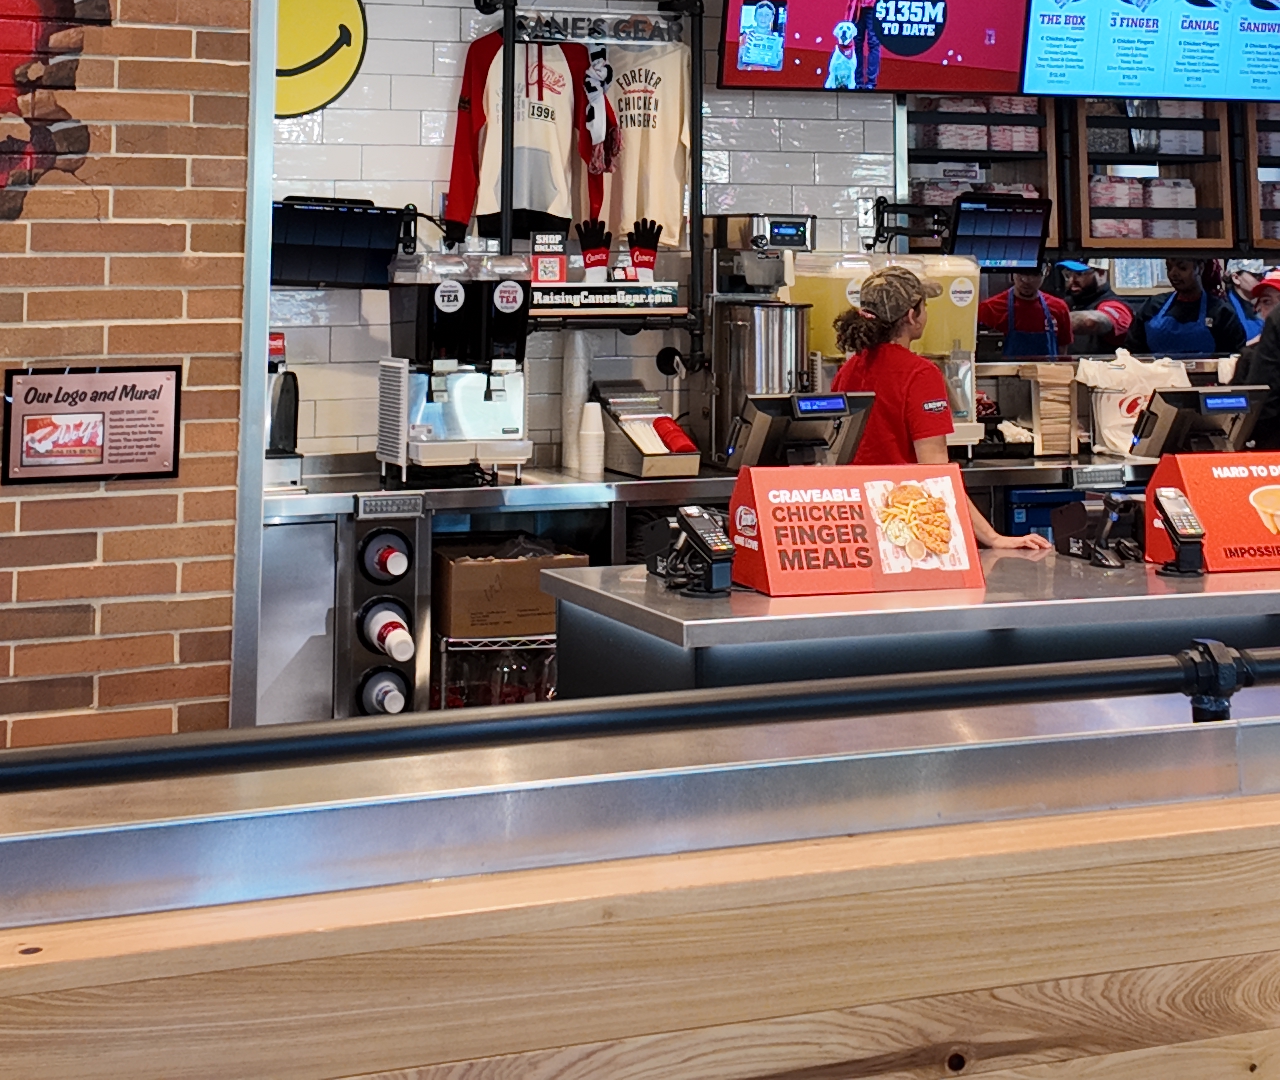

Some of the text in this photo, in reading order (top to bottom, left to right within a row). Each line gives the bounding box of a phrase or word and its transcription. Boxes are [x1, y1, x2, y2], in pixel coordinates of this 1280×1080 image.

[875, 0, 945, 23] $135M
[1039, 13, 1086, 26] THE BOX
[612, 15, 685, 42] GEAR
[881, 22, 936, 37] TO DATE
[1110, 17, 1159, 29] 3 FINGER
[1180, 19, 1220, 31] CANIAC
[615, 67, 662, 90] FOREVER
[617, 96, 660, 113] CHICKEN
[619, 113, 658, 130] FINGERS
[535, 234, 562, 244] SHOP
[534, 244, 564, 253] ONLINE
[439, 294, 459, 303] TEA
[498, 295, 518, 305] TEA
[532, 290, 673, 307] RaisingCanesGear.com
[23, 383, 164, 407] Our Logo and Mural
[1211, 466, 1249, 479] HARD
[1249, 465, 1268, 478] TO
[768, 488, 862, 504] CRAVEABLE
[771, 504, 865, 523] CHICKEN
[773, 523, 869, 547] FINGER
[778, 546, 874, 572] MEALS
